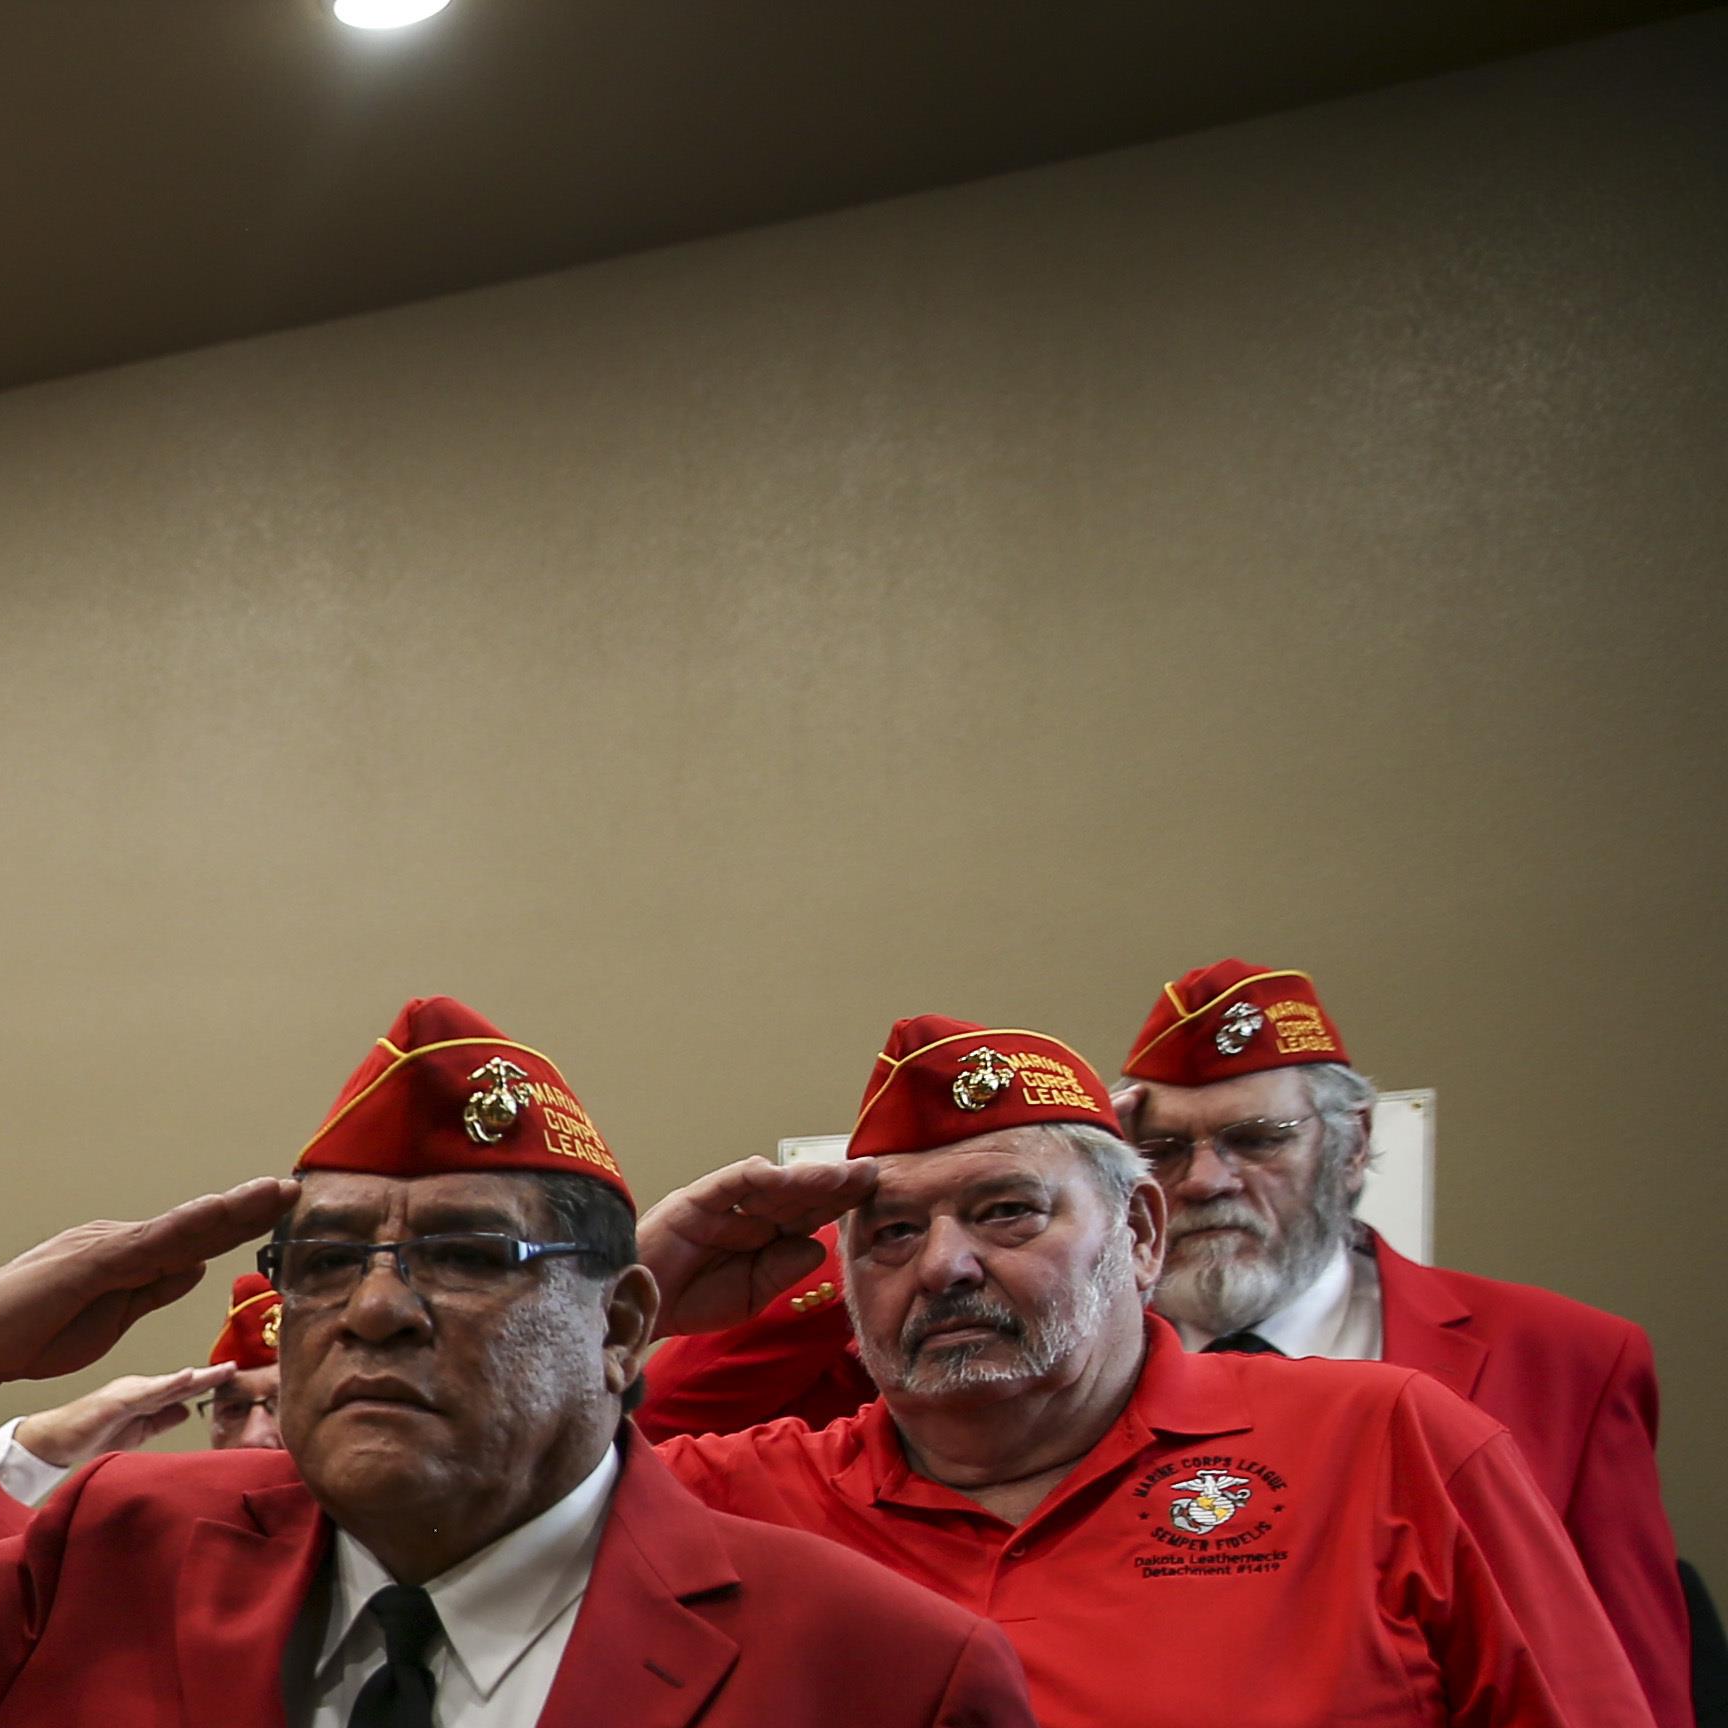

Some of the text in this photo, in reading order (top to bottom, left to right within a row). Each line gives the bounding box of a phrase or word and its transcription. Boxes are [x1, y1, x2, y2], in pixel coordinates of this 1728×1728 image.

[1264, 1000, 1321, 1024] MARINE
[1276, 1020, 1325, 1038] CORPS
[1275, 1036, 1336, 1054] LEAGUE
[1007, 1052, 1078, 1082] MARINE
[1020, 1071, 1085, 1094] CORPS
[1022, 1088, 1101, 1112] LEAGUE
[543, 1107, 606, 1151] CORPS
[543, 1129, 621, 1177] LEAGUE
[1131, 1457, 1287, 1498] MARINE CORPS LEAGUE
[1150, 1521, 1272, 1552] SEMPER FIDELIS
[1134, 1551, 1288, 1568] Dakota Leathernecks
[1142, 1566, 1231, 1579] Detachment
